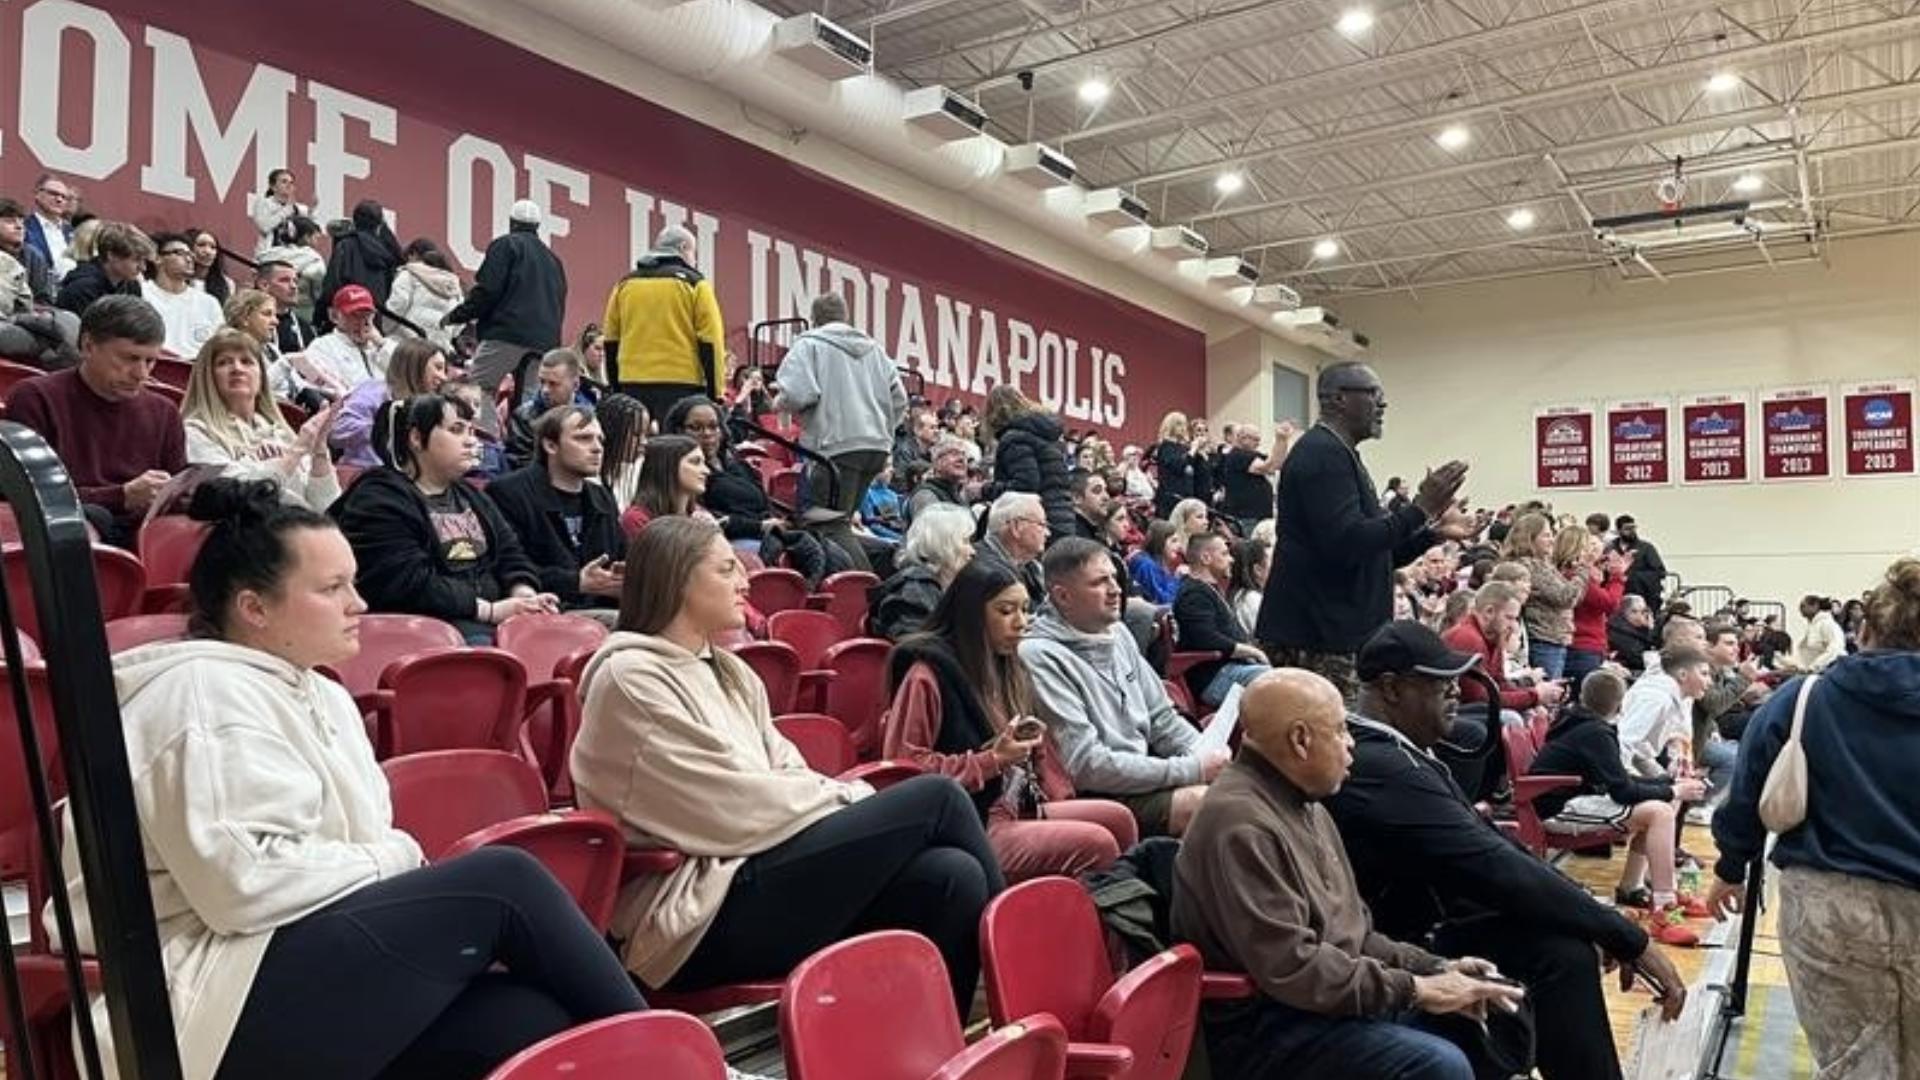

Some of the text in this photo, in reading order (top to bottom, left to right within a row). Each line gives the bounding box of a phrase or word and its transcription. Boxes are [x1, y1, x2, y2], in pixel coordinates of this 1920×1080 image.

[0, 0, 397, 238] OME
[447, 133, 590, 272] OF
[747, 229, 1125, 429] INDIANAPOLIS
[1769, 442, 1823, 456] CHAMPIONS
[1701, 461, 1731, 476] 2013
[1864, 453, 1896, 470] 2013
[1624, 465, 1652, 480] 2012
